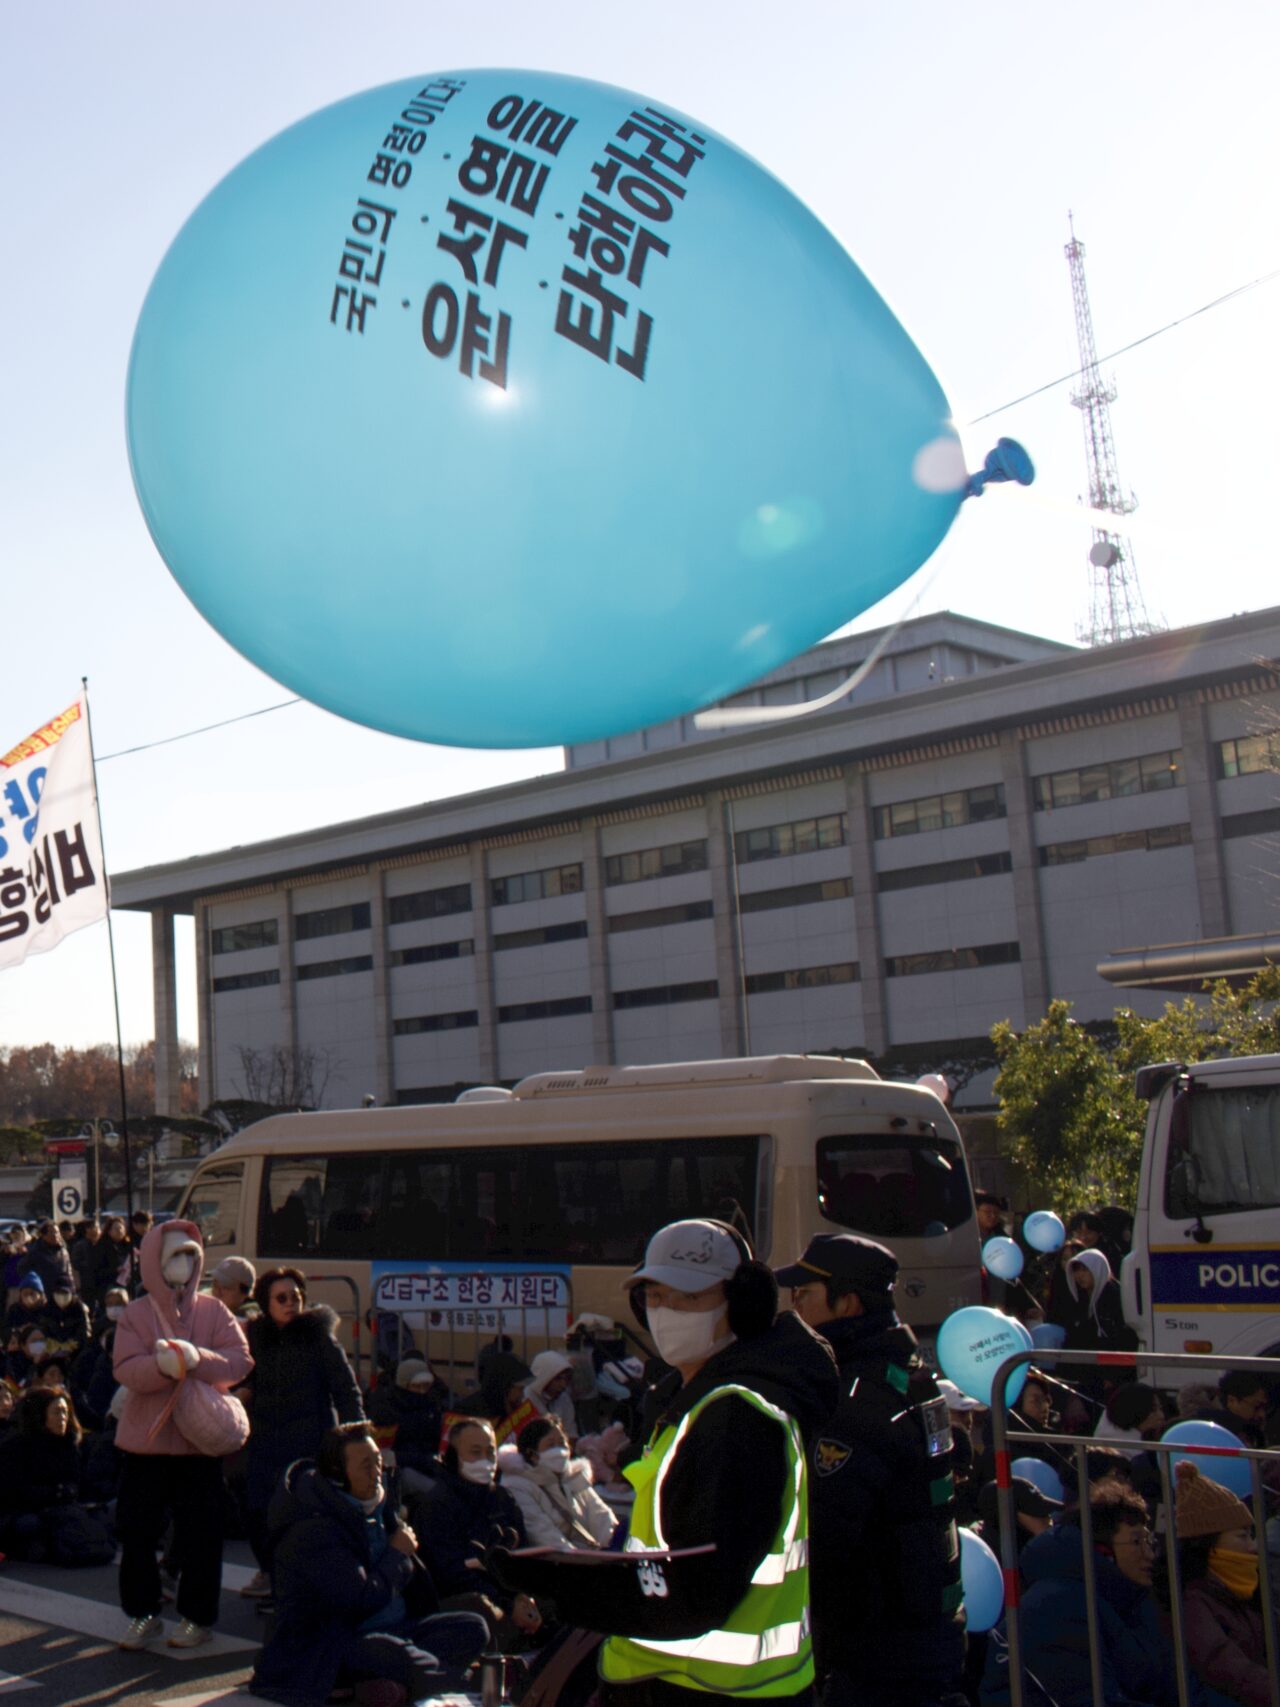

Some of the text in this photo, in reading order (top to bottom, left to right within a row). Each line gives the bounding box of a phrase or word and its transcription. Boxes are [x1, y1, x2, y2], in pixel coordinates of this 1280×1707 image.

[330, 78, 467, 336] 국민의 명령이다!
[421, 94, 580, 391] 윤석열을
[554, 106, 707, 383] 탄핵하라!
[62, 1188, 77, 1213] 5
[381, 1276, 560, 1307] 긴급구조 현장 지원단
